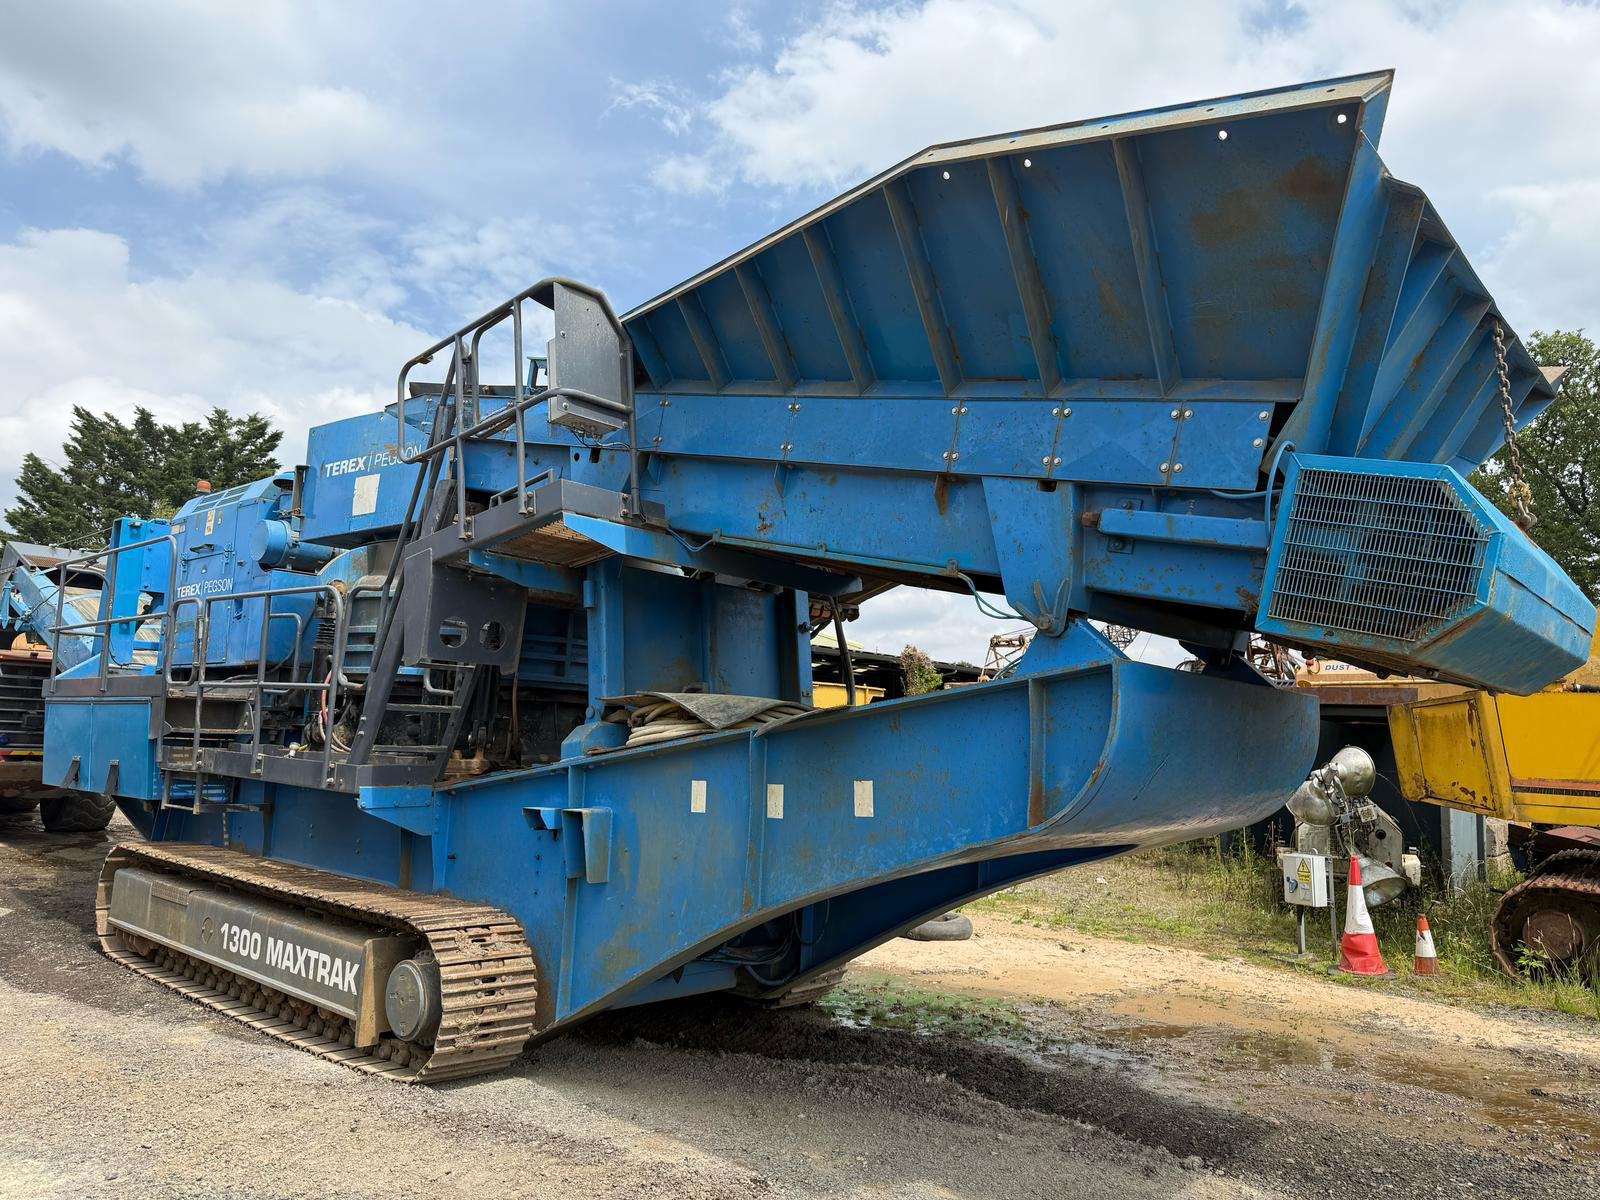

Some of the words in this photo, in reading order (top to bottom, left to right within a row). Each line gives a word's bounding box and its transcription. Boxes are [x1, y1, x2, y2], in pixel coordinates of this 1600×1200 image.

[325, 455, 367, 477] TEREX
[374, 444, 422, 467] PEGON
[177, 583, 201, 598] TEREX
[203, 578, 234, 593] PEGSON
[220, 922, 262, 961] 1300
[265, 936, 361, 996] MAXTRAK
